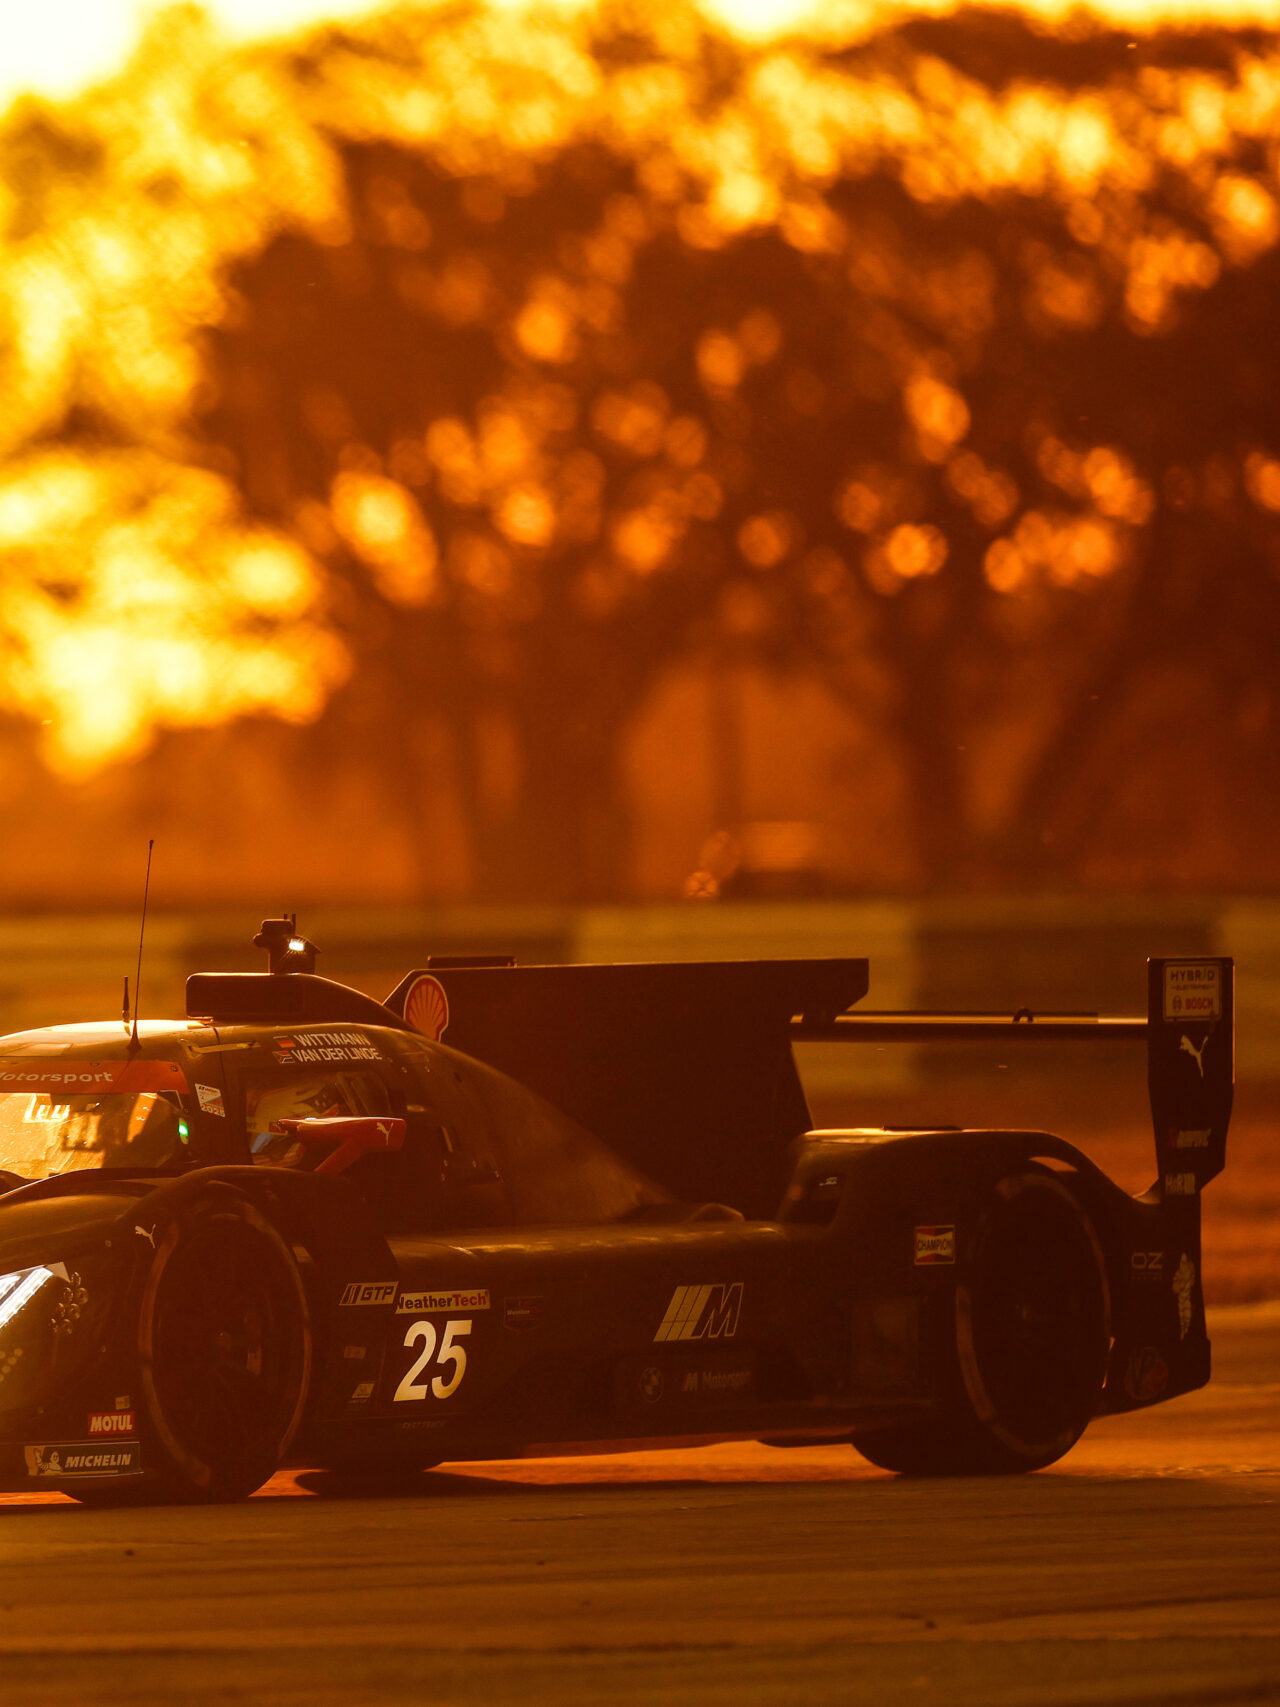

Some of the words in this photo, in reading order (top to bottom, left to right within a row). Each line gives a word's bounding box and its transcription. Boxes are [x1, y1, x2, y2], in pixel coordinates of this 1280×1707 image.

[1170, 969, 1216, 982] HYBRID
[1185, 998, 1213, 1010] BOSCH
[293, 1033, 371, 1047] WITTMANN
[291, 1049, 322, 1062] VAN
[318, 1048, 349, 1061] DER
[344, 1047, 382, 1060] LINDE
[1131, 1252, 1163, 1269] OZ
[360, 1286, 394, 1302] GTP
[393, 1319, 473, 1402] 25
[90, 1414, 133, 1433] MOTUL
[64, 1453, 132, 1468] MICHELIN
